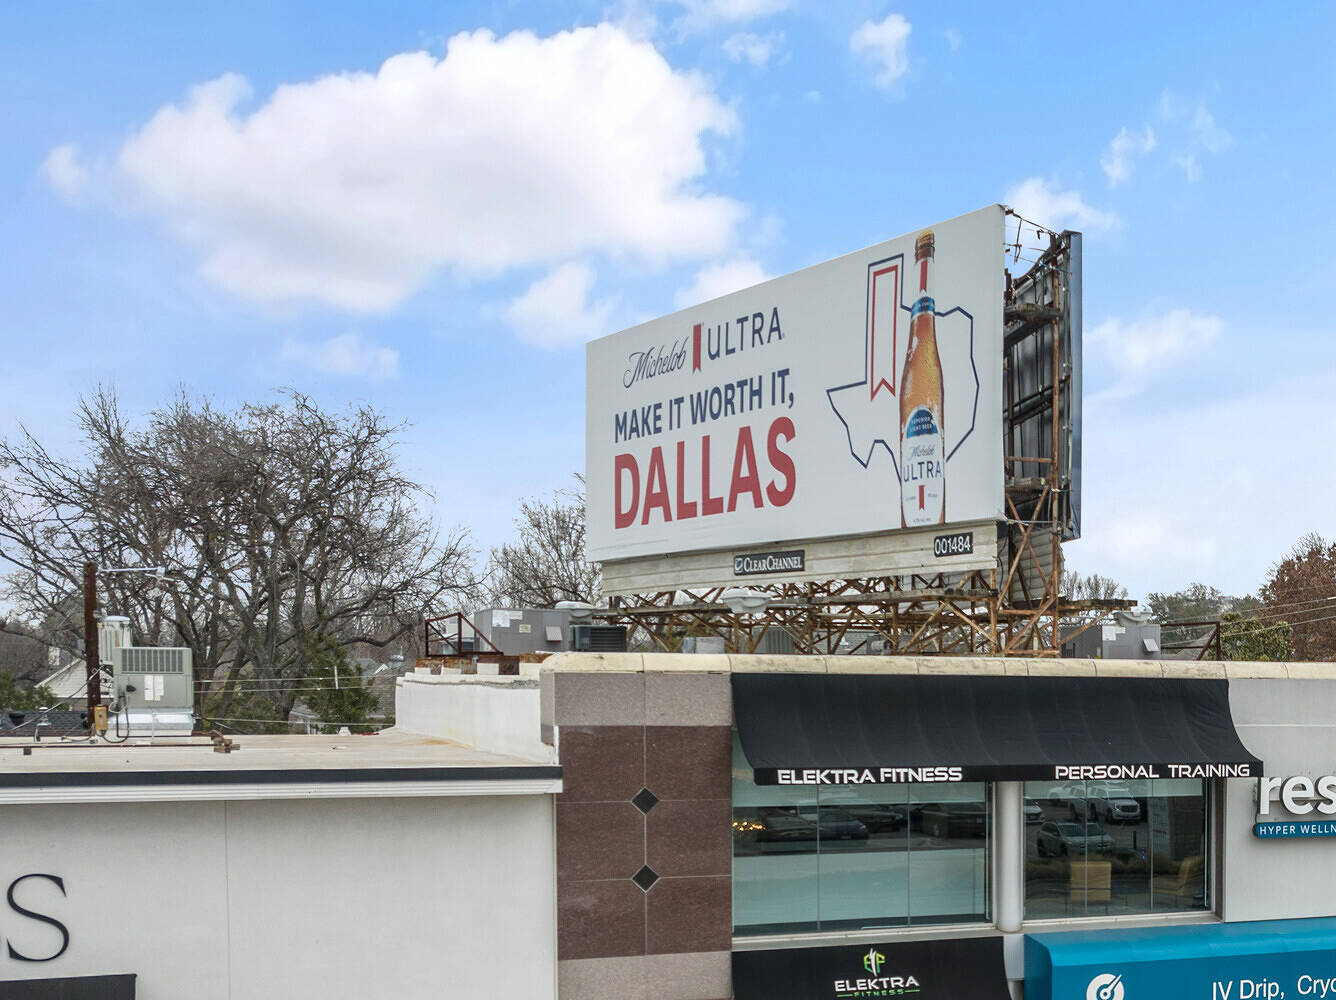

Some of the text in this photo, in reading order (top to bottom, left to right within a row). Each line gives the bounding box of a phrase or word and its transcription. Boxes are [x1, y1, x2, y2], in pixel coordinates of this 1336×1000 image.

[623, 307, 784, 388] Michelob ULTRA
[615, 368, 794, 443] MAKE IT WORTH IT,
[615, 416, 796, 529] DALLAS
[903, 461, 942, 482] ULTRA
[934, 535, 971, 555] 001484
[777, 767, 963, 785] ELEKTRA FITNESS
[1055, 764, 1250, 780] PERSONAL TRAINING
[1259, 825, 1296, 835] HYPER
[834, 976, 920, 992] ELEKTRA
[854, 989, 904, 997] FITNESS
[1212, 981, 1233, 1000] IV
